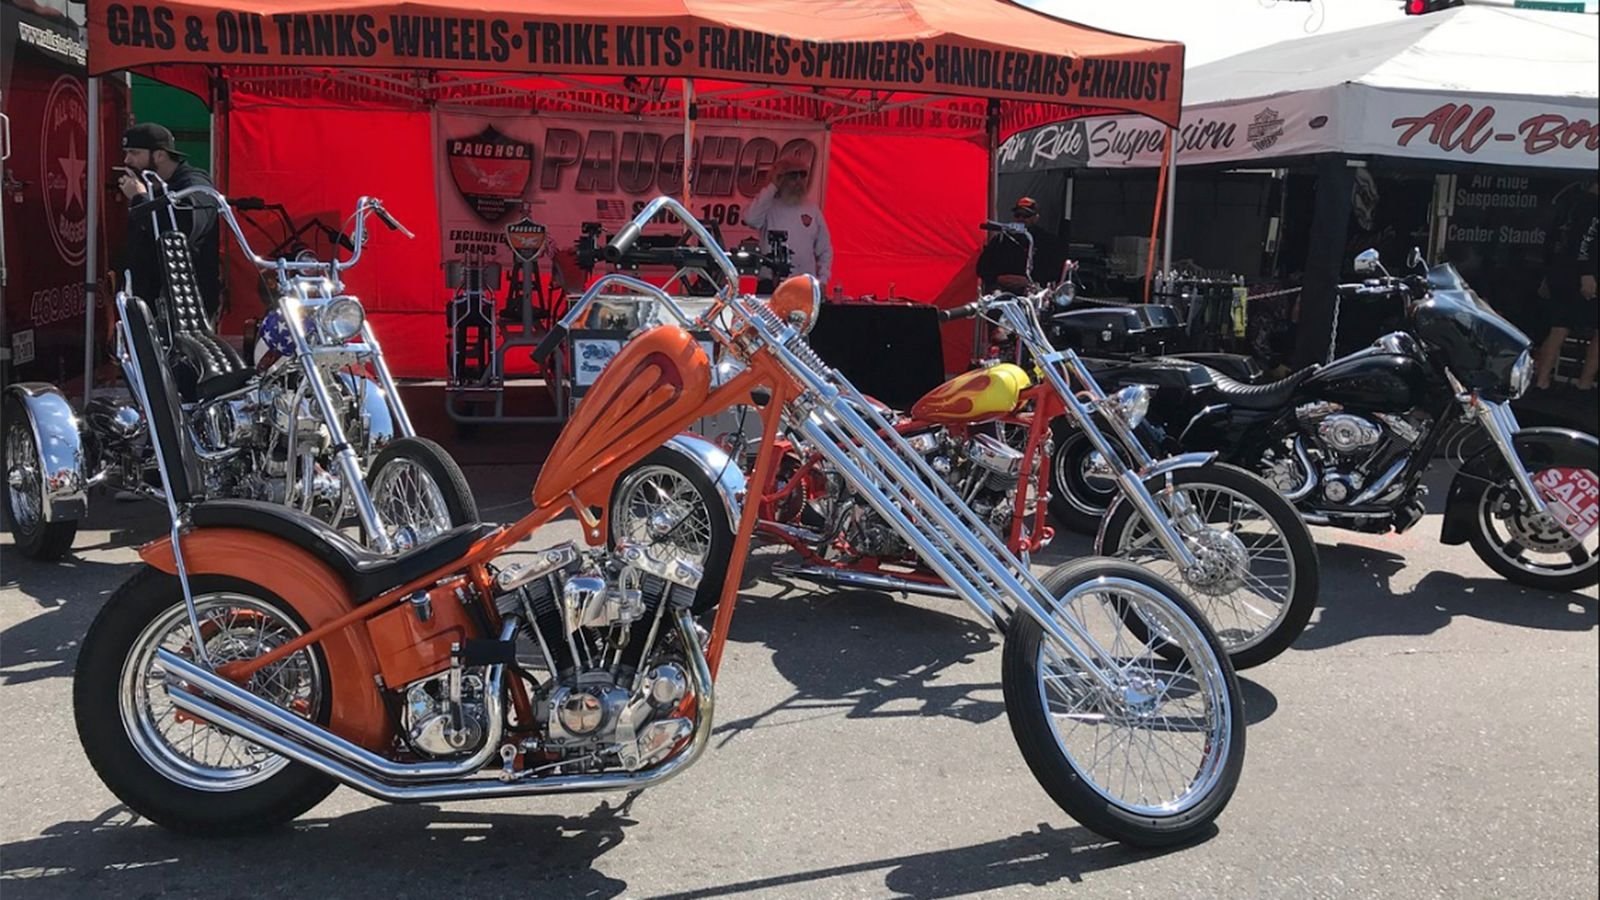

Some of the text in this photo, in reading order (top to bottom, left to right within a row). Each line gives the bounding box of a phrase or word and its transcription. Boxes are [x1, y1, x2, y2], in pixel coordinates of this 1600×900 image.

[107, 4, 1170, 101] GAS & OIL TANKS WHEELS TRIKE KITS FRAMES SPRINGERS HANDLEBARS EXHAUST
[453, 142, 525, 157] PAUGHCO
[1029, 125, 1085, 168] Ride
[1089, 118, 1237, 162] Suspesion
[540, 127, 817, 198] PAUGHCO
[1456, 188, 1538, 211] Suspension
[701, 203, 748, 227] 196
[450, 230, 508, 244] EXCLUSIVE
[1448, 224, 1547, 244] Center Stands
[455, 243, 497, 256] BRANDS
[1568, 470, 1599, 498] FOR
[1541, 469, 1599, 524] SALE
